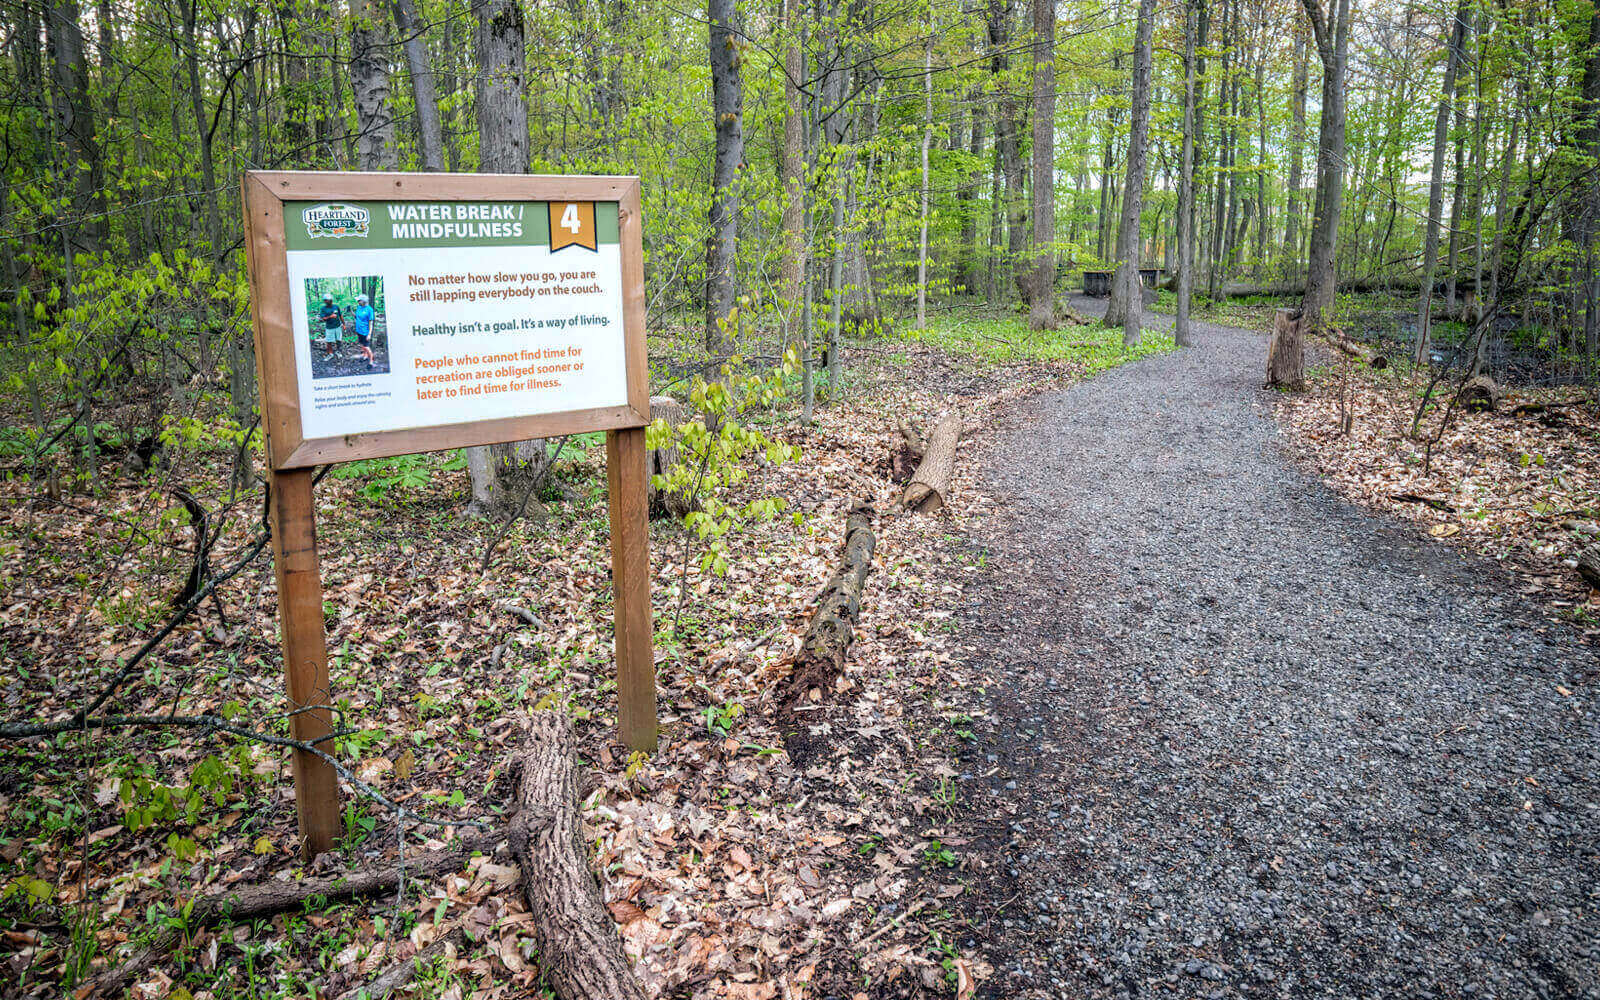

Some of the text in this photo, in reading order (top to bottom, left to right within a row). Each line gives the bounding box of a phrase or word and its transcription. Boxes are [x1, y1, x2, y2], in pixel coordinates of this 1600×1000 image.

[308, 210, 366, 222] HEARTLAND
[388, 205, 524, 221] WATER BREAK /
[560, 205, 581, 234] 4
[324, 219, 352, 227] FOREST
[392, 222, 522, 238] MINDFULNESS
[408, 270, 596, 286] No matter how slow you go, you are
[409, 284, 603, 302] still lapping everybody on the couch.
[412, 323, 456, 338] Healthy
[484, 323, 491, 332] a
[493, 319, 519, 333] goal.
[546, 319, 566, 330] way
[569, 315, 579, 326] of
[581, 314, 610, 326] living.
[415, 346, 582, 370] People who cannot find time for
[416, 362, 584, 384] recreation are obliged sooner or
[417, 377, 561, 401] later to find time for illness.
